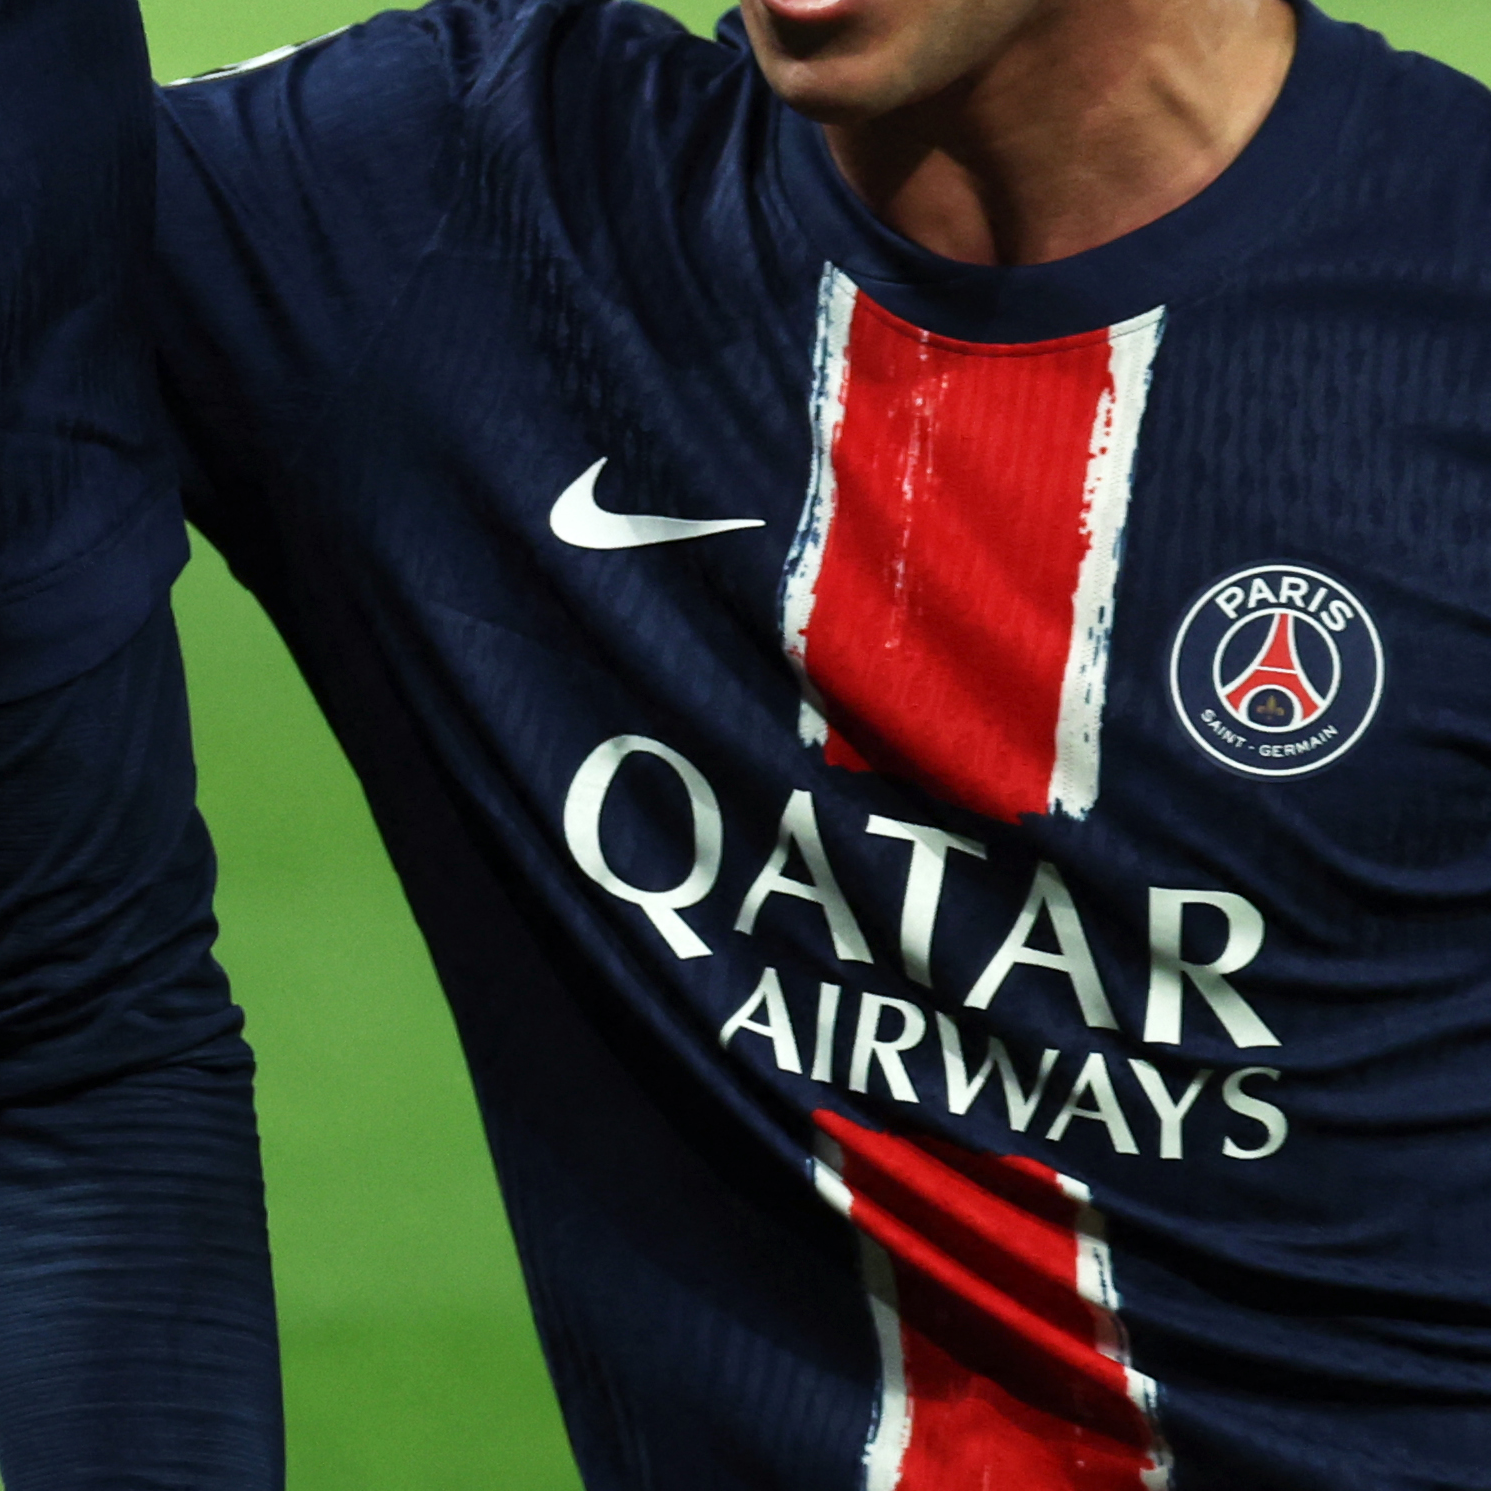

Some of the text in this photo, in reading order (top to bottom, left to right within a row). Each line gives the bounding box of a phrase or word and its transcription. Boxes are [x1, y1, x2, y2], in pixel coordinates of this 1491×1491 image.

[1214, 575, 1355, 632] PARIS
[1200, 708, 1247, 748] SAINT
[1258, 724, 1339, 758] GERMAIN
[562, 734, 1283, 1049] QATAR
[719, 966, 1288, 1160] AIRWAYS
